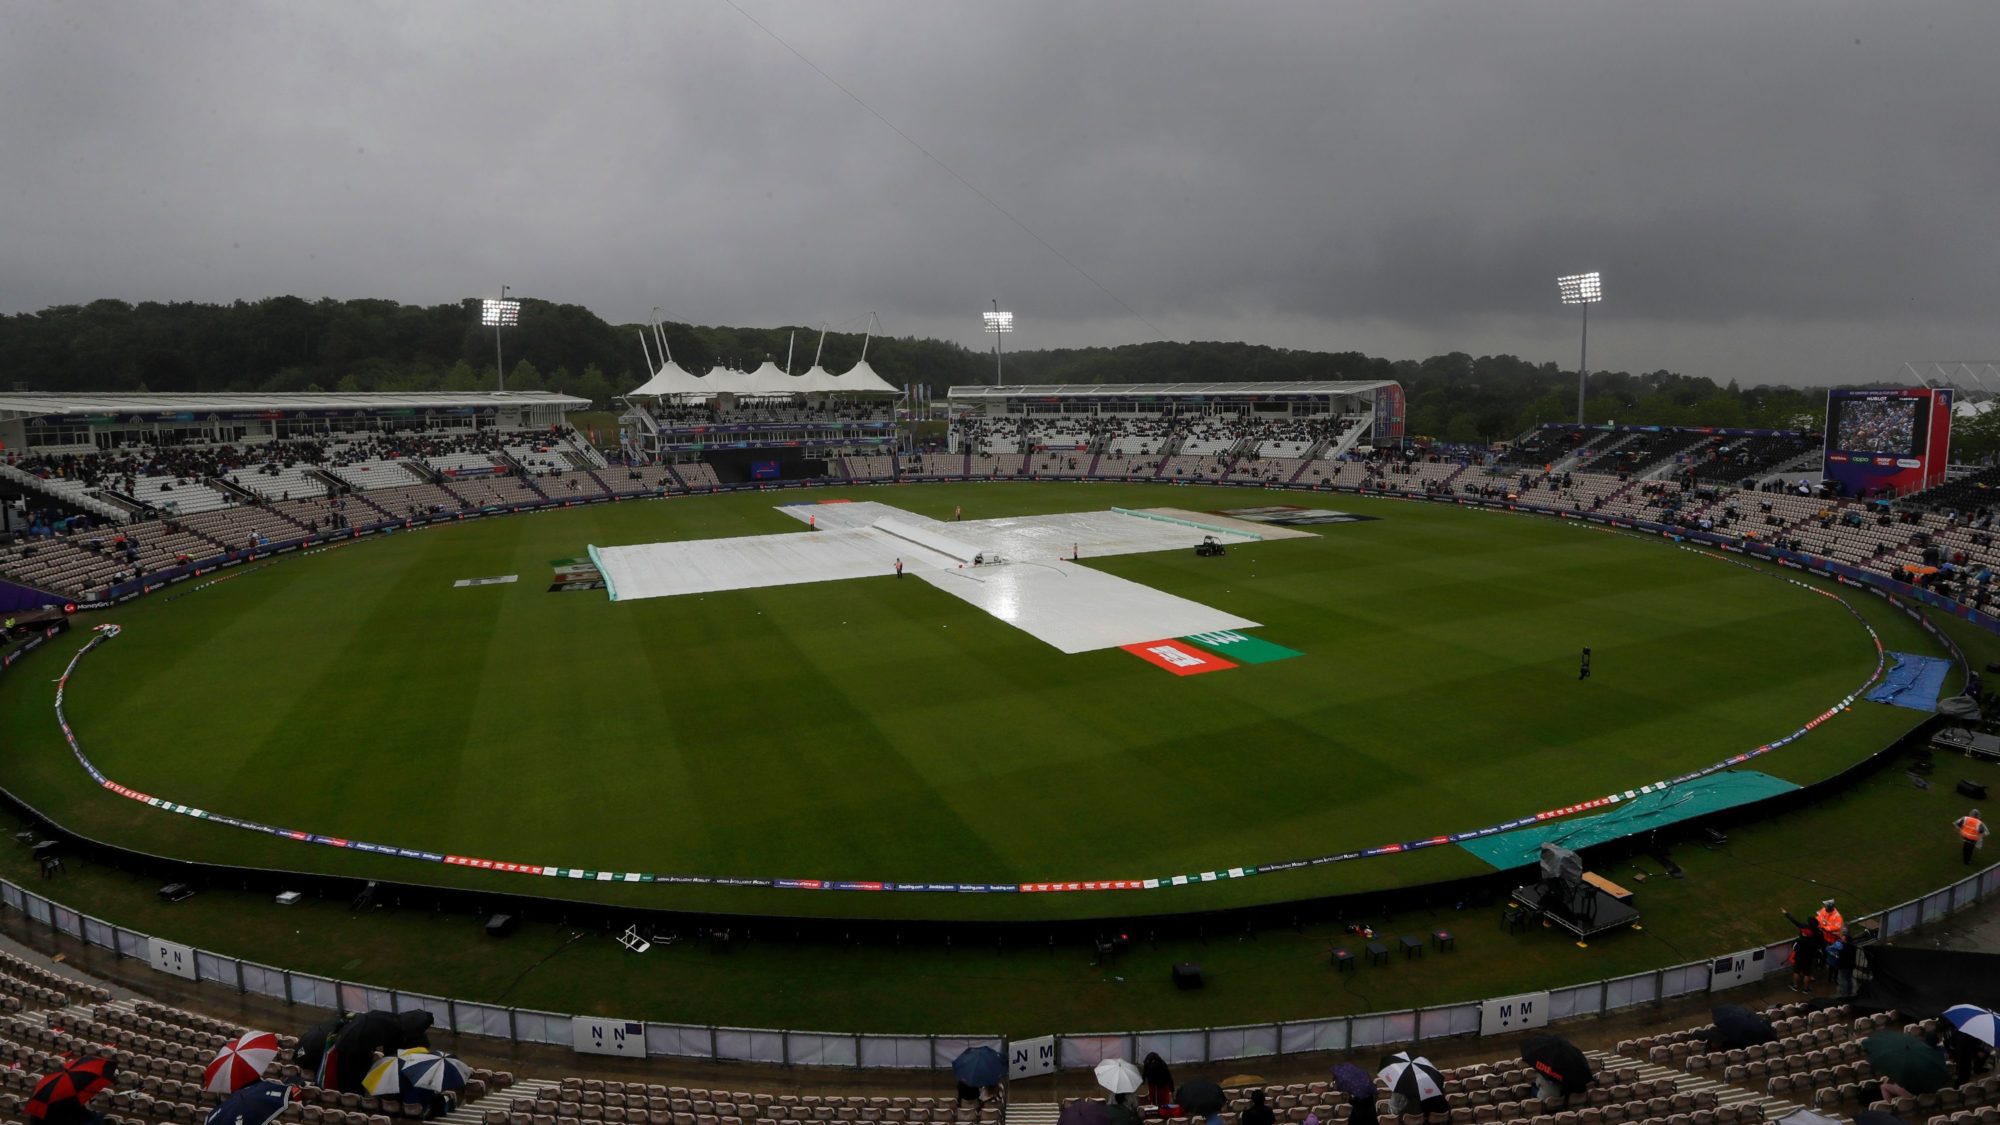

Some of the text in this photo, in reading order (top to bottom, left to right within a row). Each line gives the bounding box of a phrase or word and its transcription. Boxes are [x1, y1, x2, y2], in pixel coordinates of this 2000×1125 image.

[161, 947, 182, 963] P N
[1735, 959, 1745, 972] M
[1500, 1002, 1532, 1018] M M
[592, 1025, 625, 1041] N N
[1017, 1045, 1053, 1063] N M
